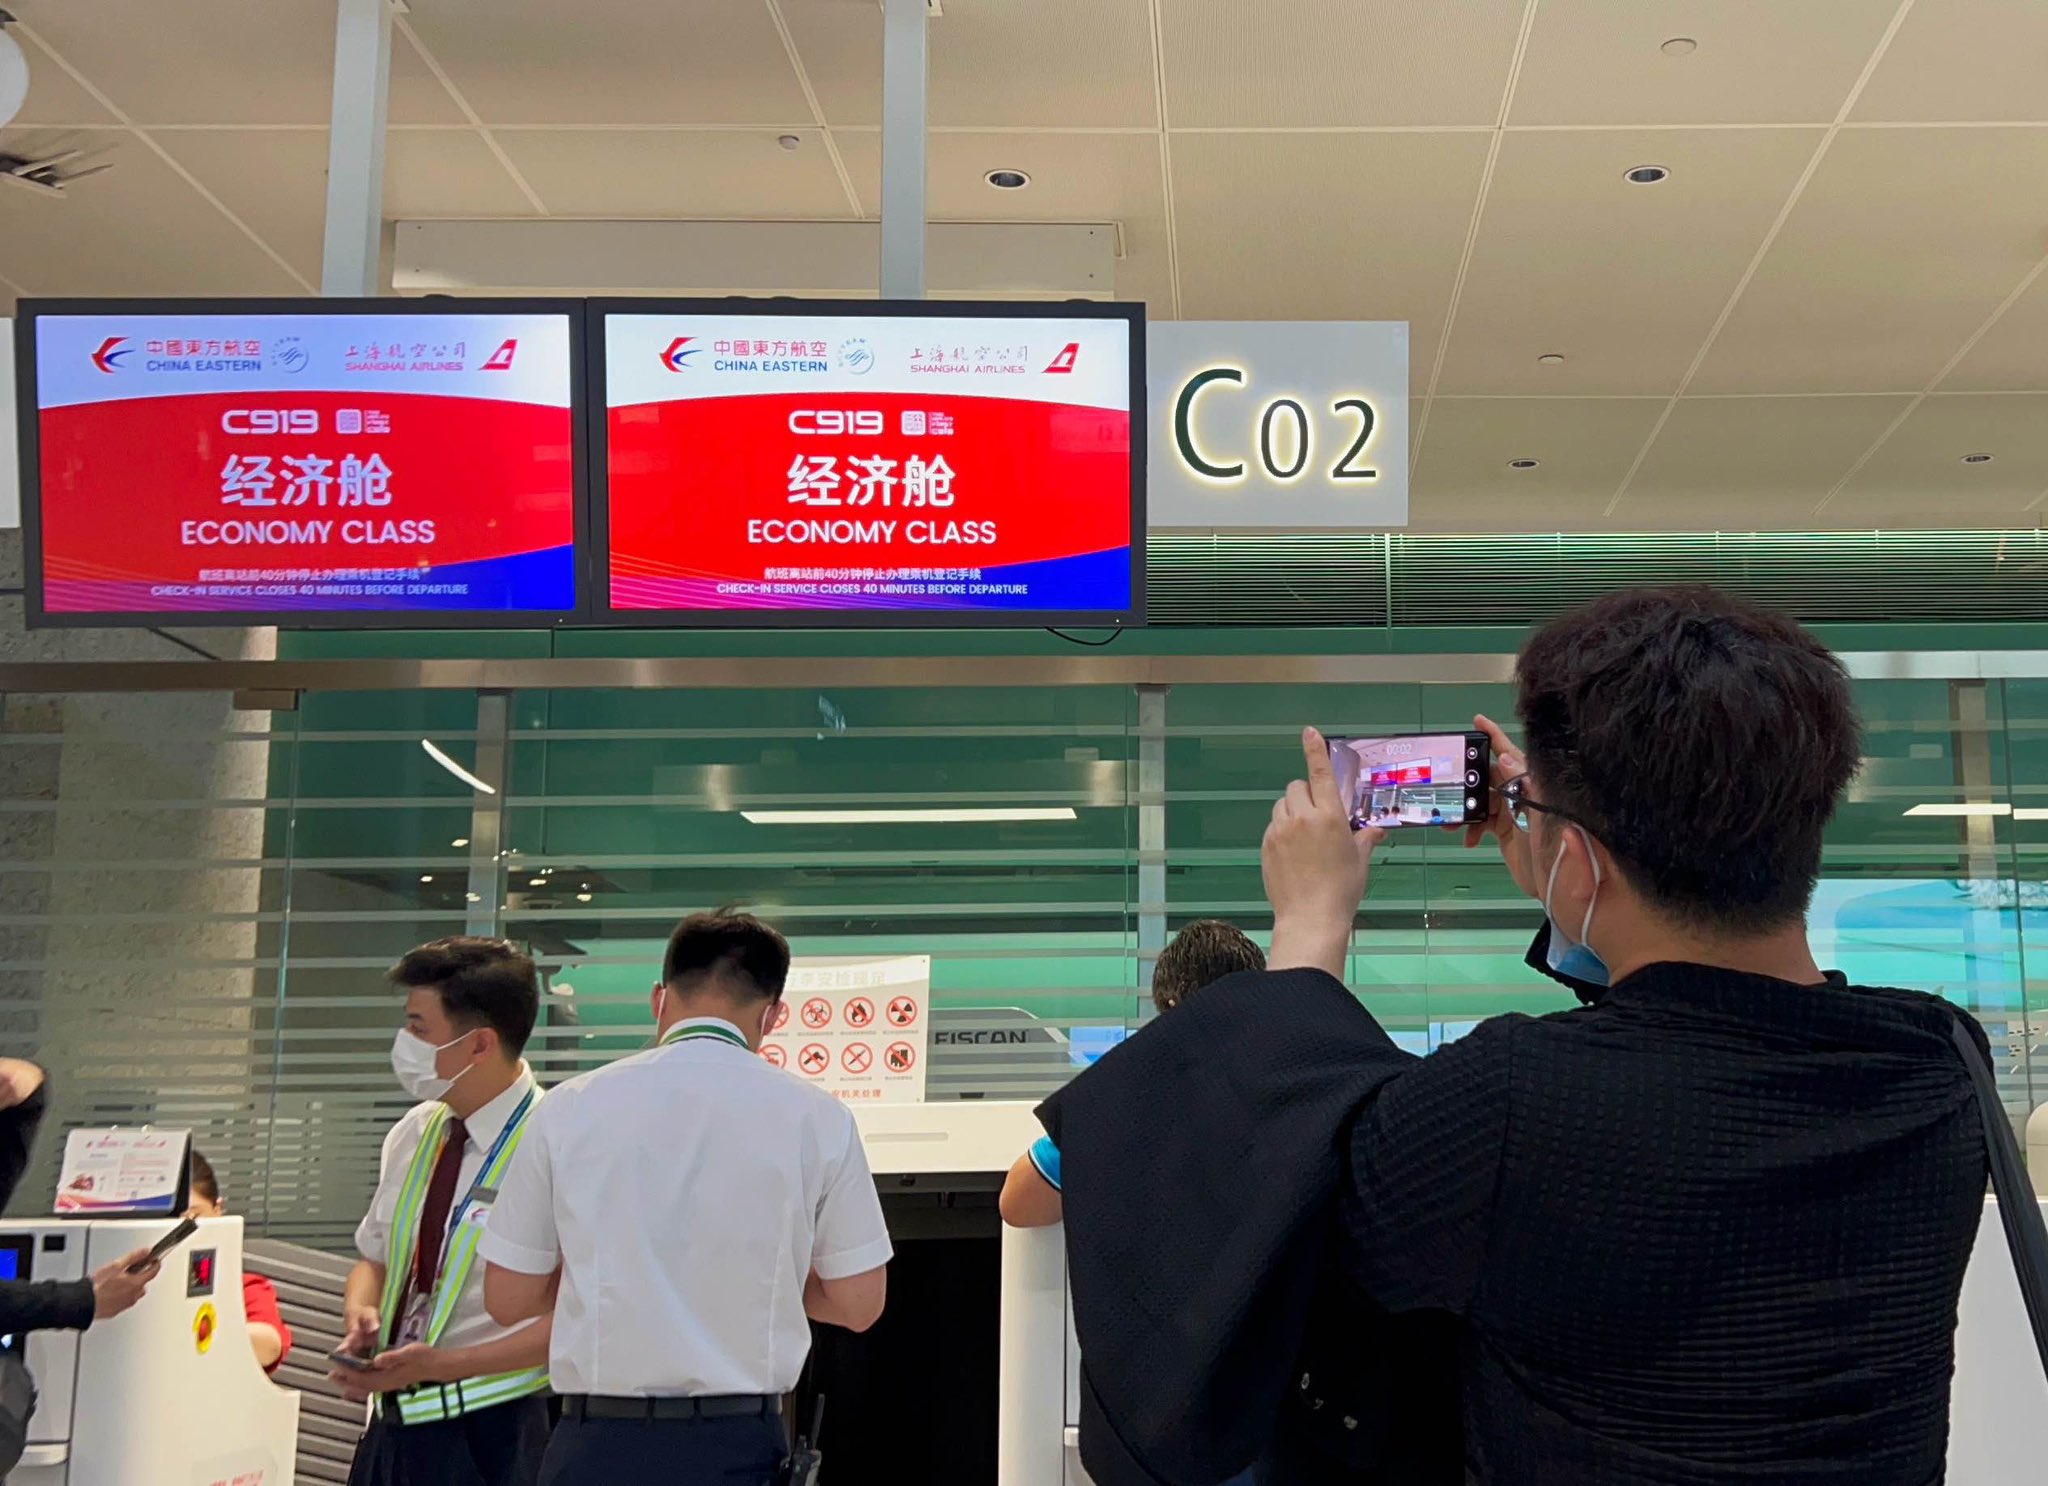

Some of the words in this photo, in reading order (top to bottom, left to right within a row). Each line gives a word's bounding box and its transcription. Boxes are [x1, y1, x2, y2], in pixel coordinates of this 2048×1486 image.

[713, 340, 827, 357] 中國東方航空
[146, 360, 191, 372] CHINA
[196, 360, 262, 372] EASTERN
[345, 362, 406, 372] SHANGHAI
[409, 361, 464, 371] AIRLINES
[714, 360, 758, 372] CHINA
[763, 360, 828, 372] EASTERN
[910, 364, 970, 374] SHANGHAI
[975, 364, 1026, 374] AIRLINES
[221, 409, 319, 434] C919
[788, 410, 883, 435] C919
[1174, 367, 1377, 479] C02
[220, 453, 393, 508] 经济舱
[787, 453, 956, 507] 经济舱
[181, 519, 332, 545] ECONOMY
[341, 519, 435, 544] CLASS
[747, 520, 897, 544] ECONOMY
[905, 520, 997, 544] CLASS
[151, 585, 207, 596] CHECK-IN
[208, 585, 253, 596] SERVICE
[255, 585, 297, 595] CLOSES
[316, 585, 362, 595] MINUTES
[364, 584, 405, 595] BEFORE
[407, 584, 469, 595] DEPARTURE
[716, 583, 771, 594] CHECK-IN
[774, 583, 817, 594] SERVICE
[819, 583, 860, 593] CLOSES
[863, 584, 878, 594] 40
[880, 584, 926, 594] MINUTES
[928, 584, 966, 594] BEFORE
[969, 584, 1028, 594] DEPARTURE
